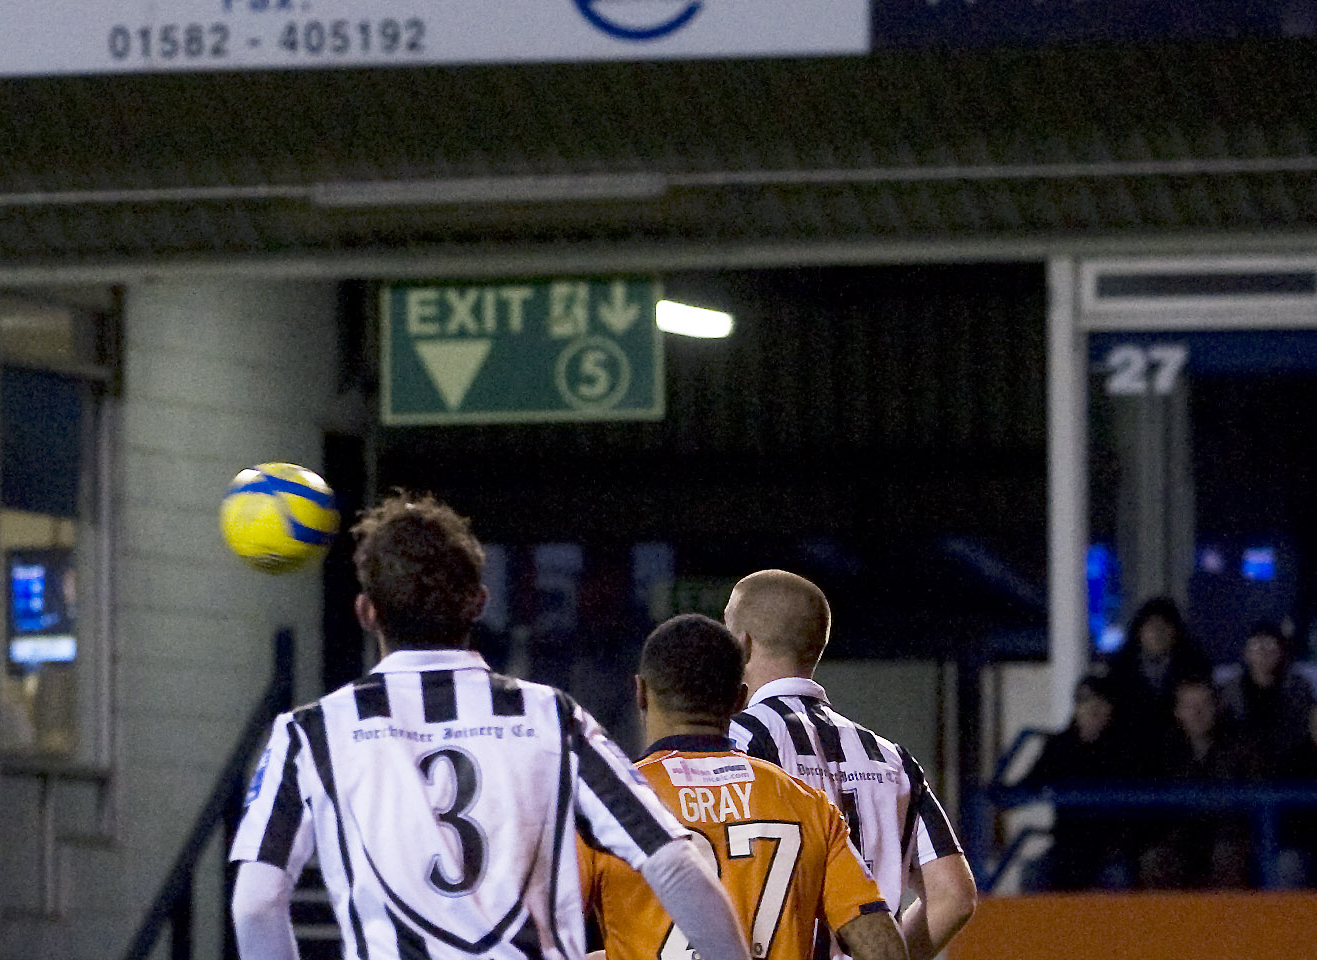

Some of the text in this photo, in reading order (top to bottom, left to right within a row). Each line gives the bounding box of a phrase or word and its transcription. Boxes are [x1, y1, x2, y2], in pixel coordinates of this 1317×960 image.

[107, 23, 231, 60] 01582
[278, 18, 427, 54] 405192
[406, 286, 534, 336] EXIT
[578, 342, 611, 398] 5
[1106, 346, 1186, 395] 27
[419, 745, 490, 898] 3
[678, 782, 752, 824] GRAY
